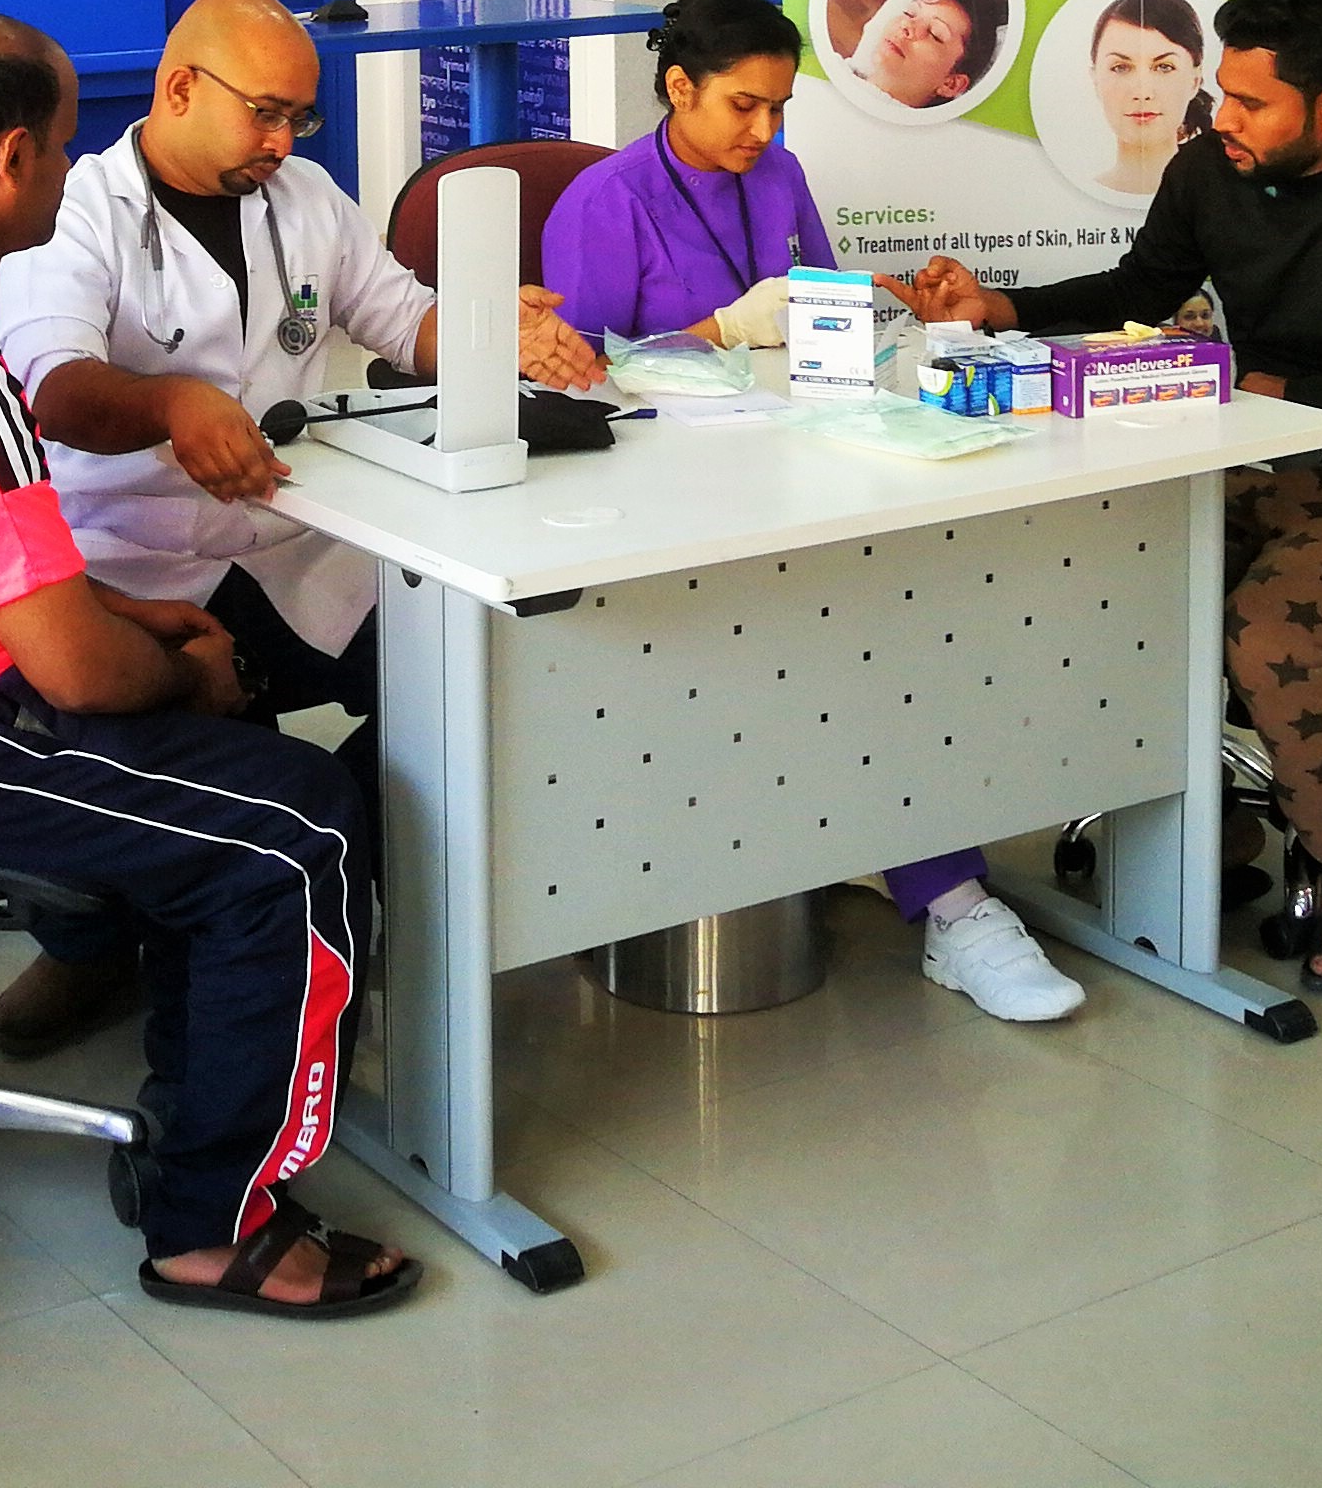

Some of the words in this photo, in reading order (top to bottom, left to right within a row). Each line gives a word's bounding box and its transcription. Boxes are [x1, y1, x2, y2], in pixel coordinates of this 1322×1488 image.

[836, 206, 936, 227] Services:
[856, 235, 930, 255] Treatment
[932, 234, 949, 251] of
[950, 233, 971, 250] all
[974, 231, 1015, 252] types
[1017, 230, 1032, 248] of
[1036, 229, 1072, 248] Skin,
[1077, 227, 1106, 245] Hair
[1111, 227, 1120, 244] &
[974, 265, 1020, 286] tology
[1097, 354, 1194, 376] Neogloves-PF
